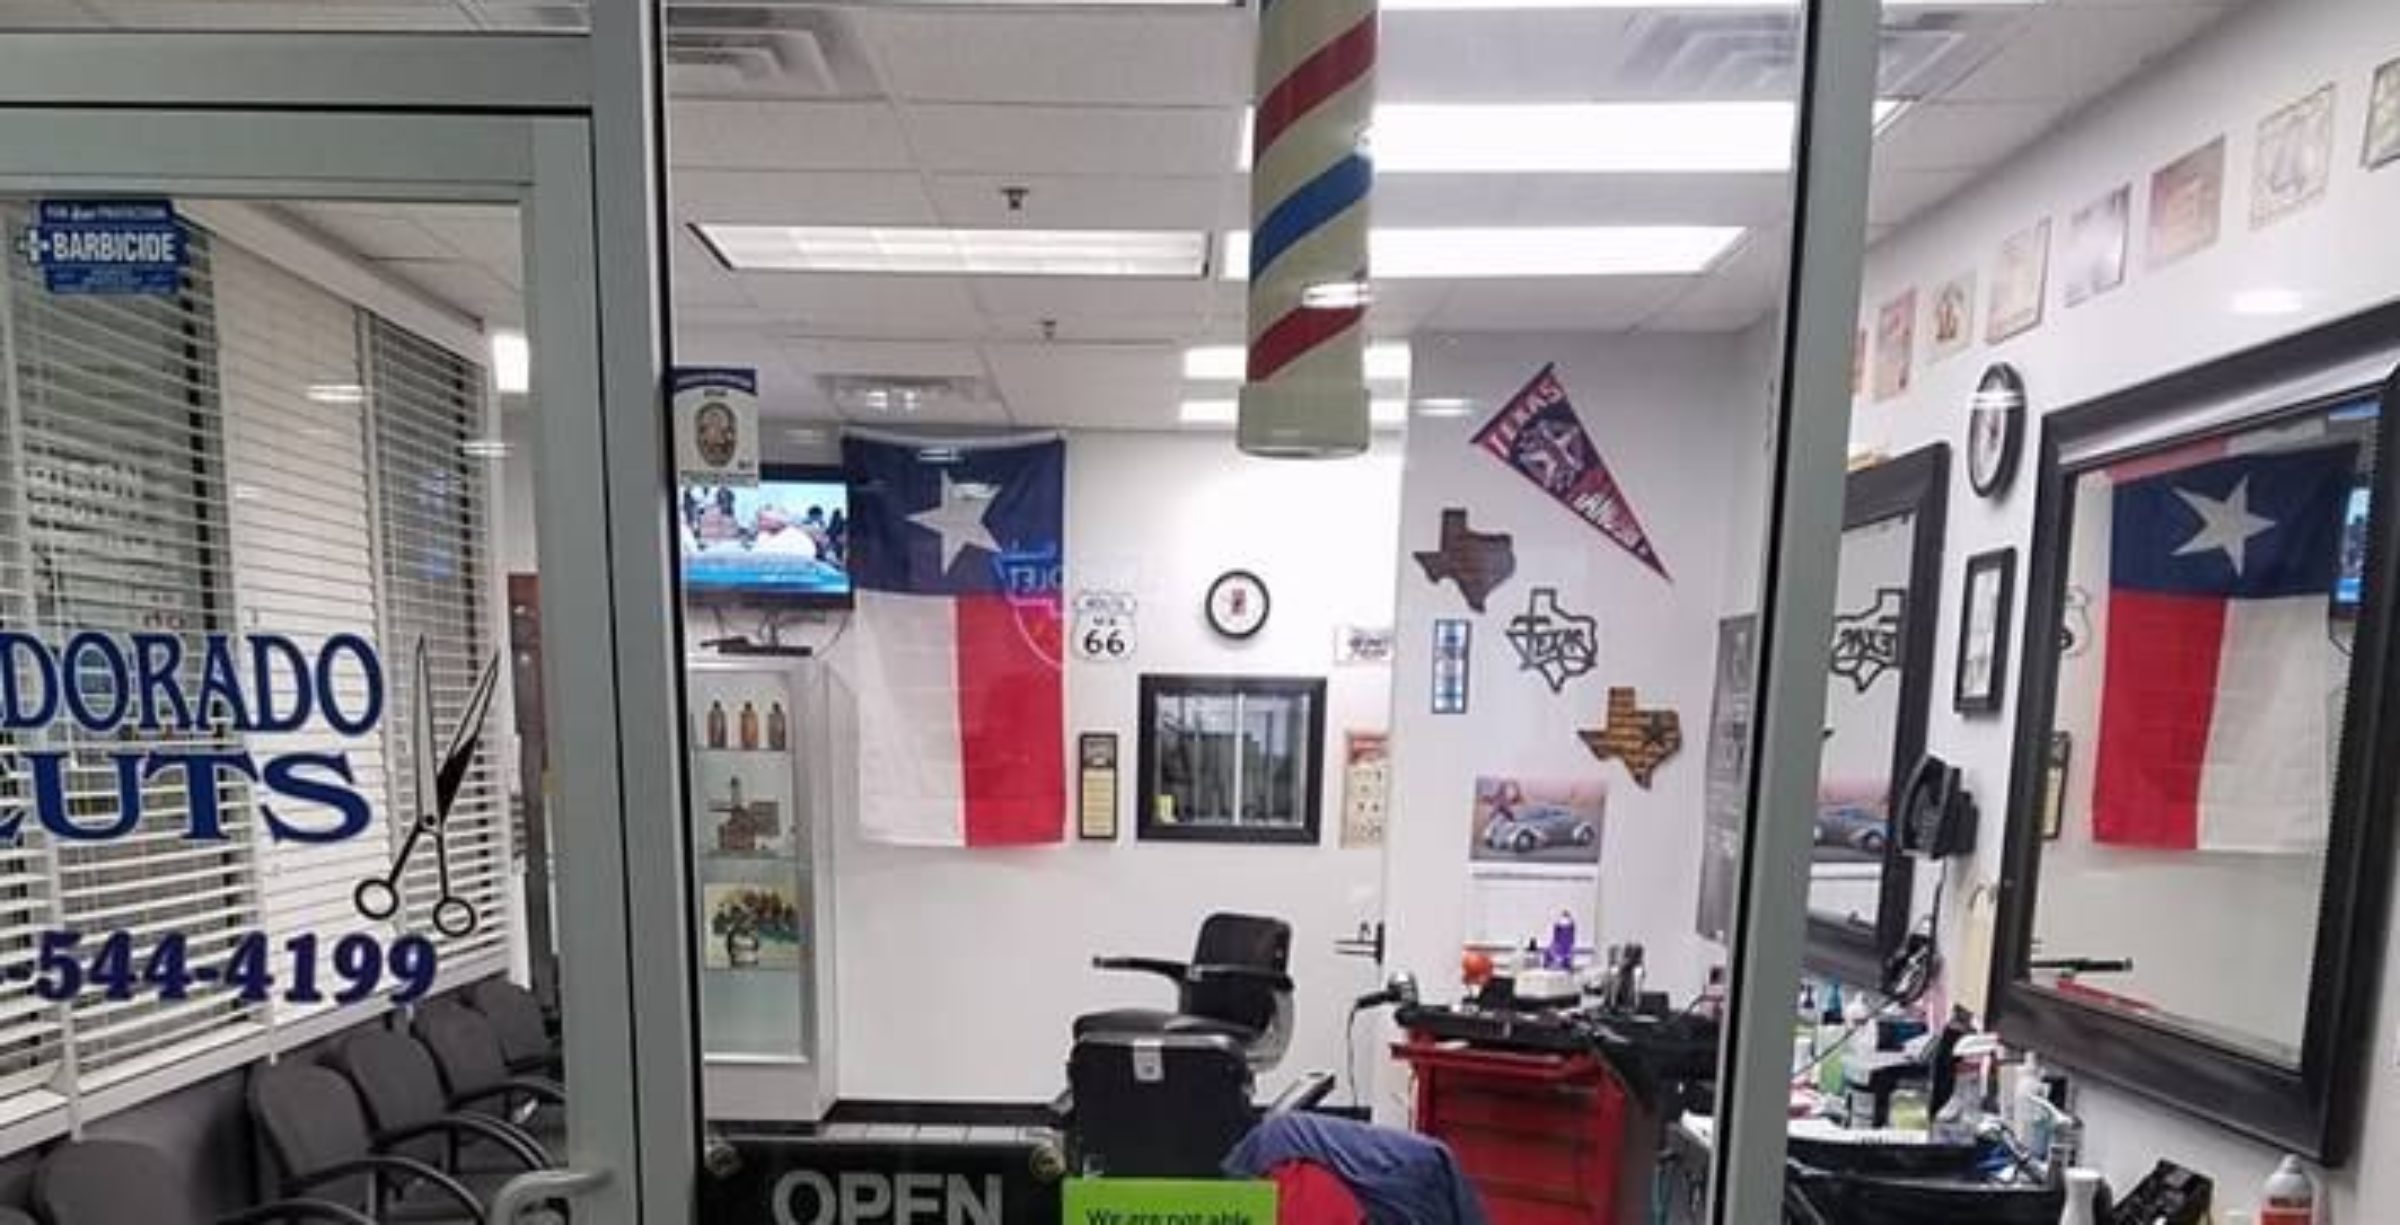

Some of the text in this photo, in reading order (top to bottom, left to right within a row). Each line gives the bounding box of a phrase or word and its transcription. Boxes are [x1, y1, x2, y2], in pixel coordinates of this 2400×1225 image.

[53, 232, 177, 262] BARBICIDE
[1082, 628, 1125, 655] 66
[0, 632, 385, 735] DORADO
